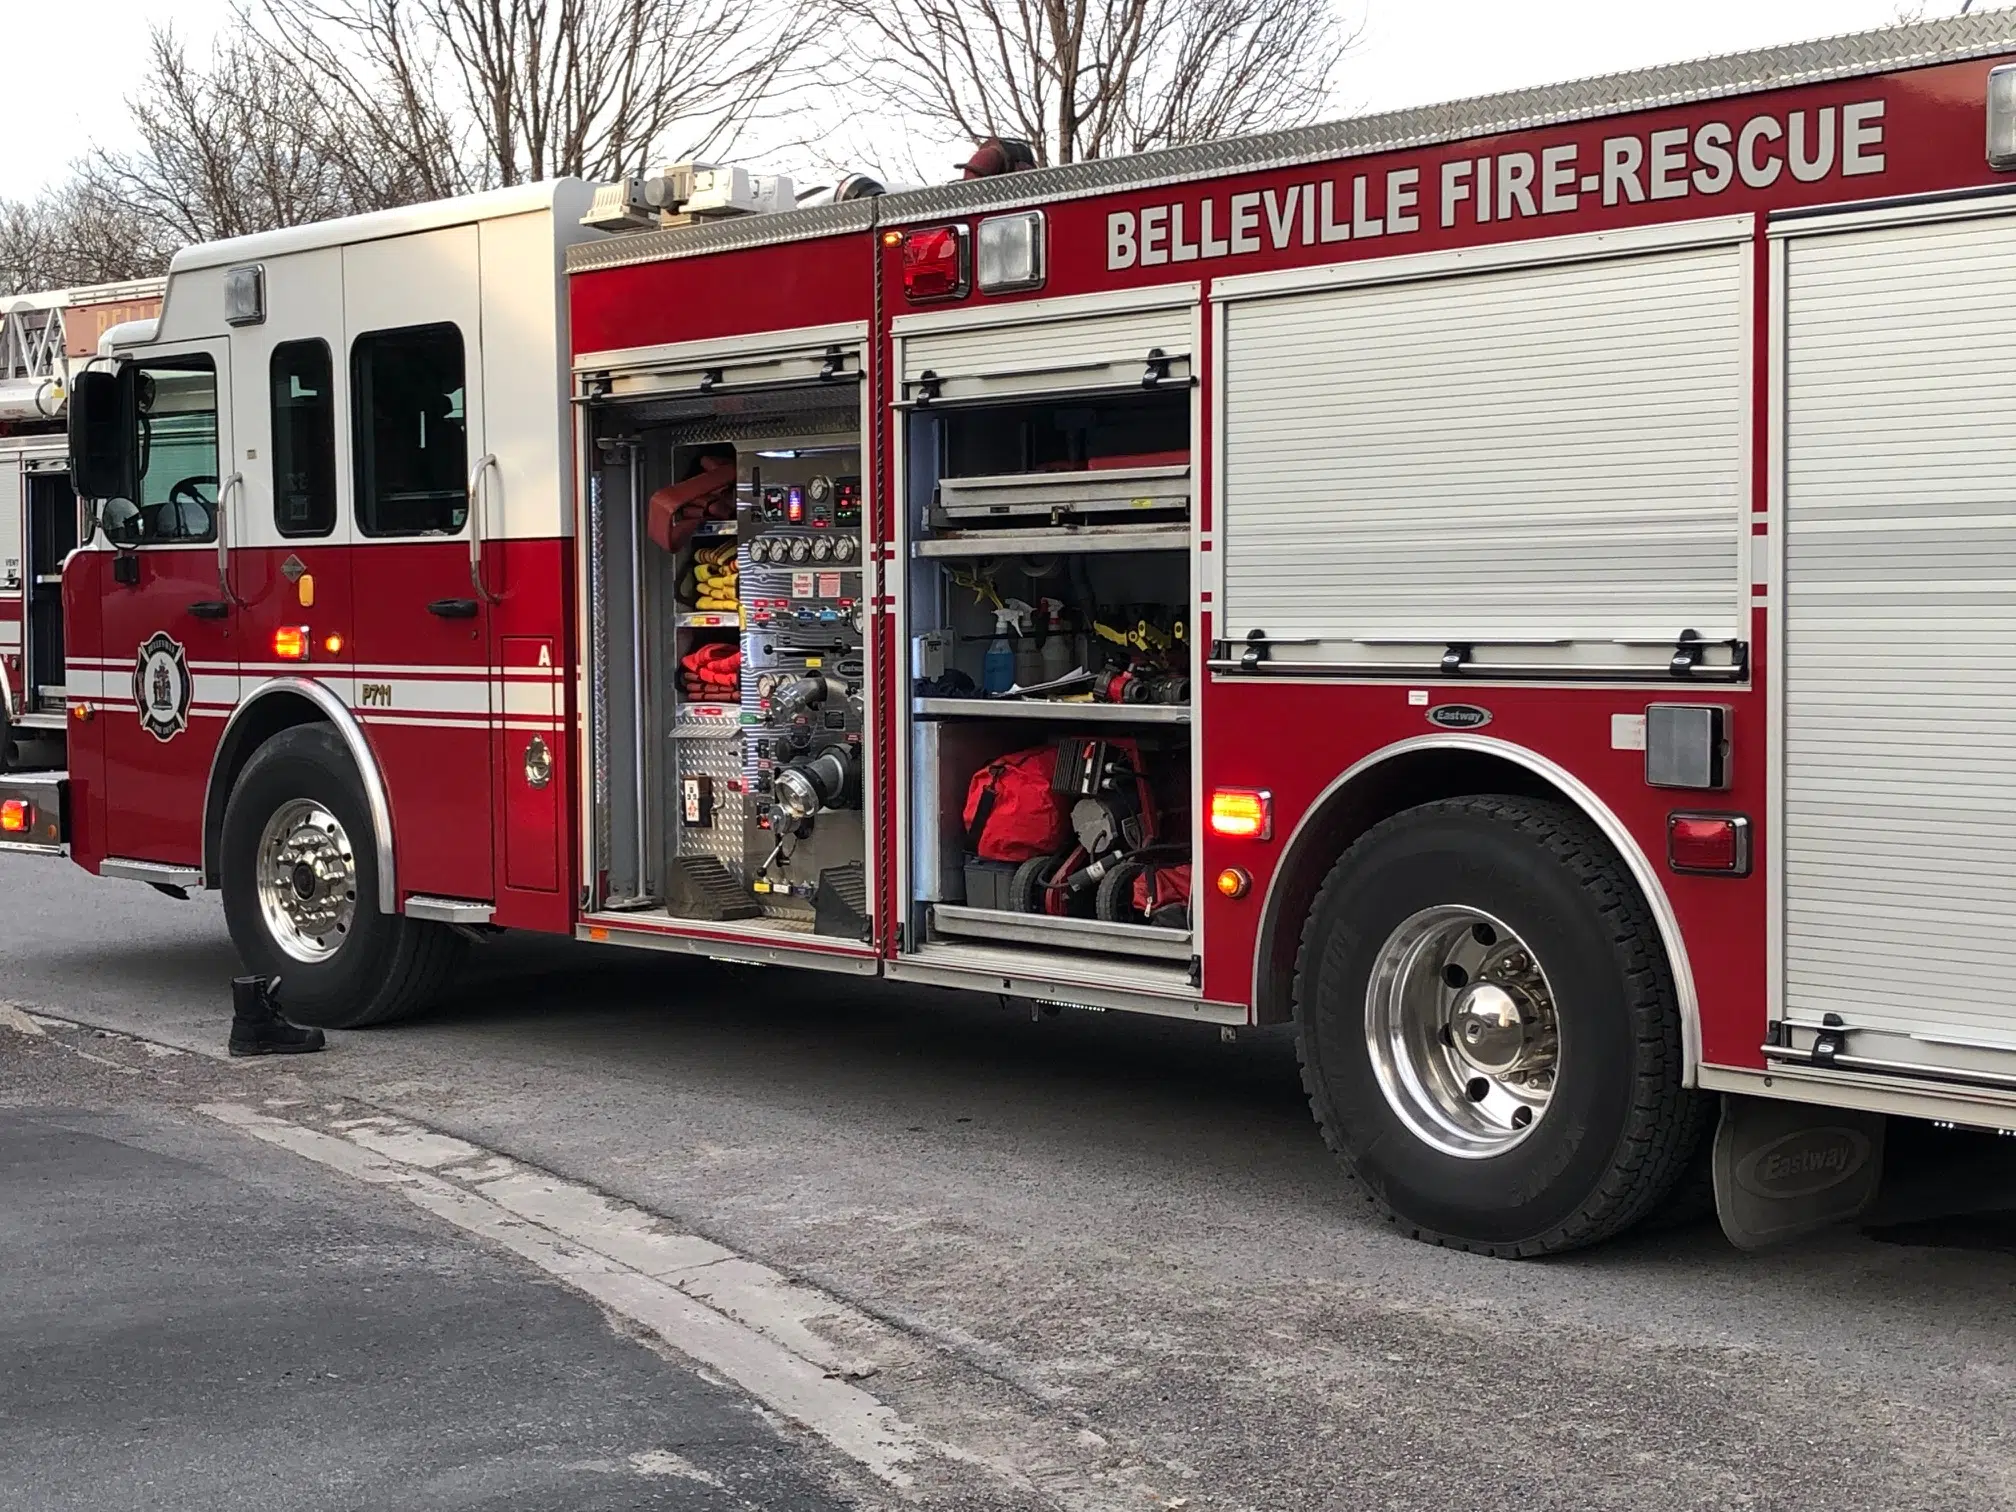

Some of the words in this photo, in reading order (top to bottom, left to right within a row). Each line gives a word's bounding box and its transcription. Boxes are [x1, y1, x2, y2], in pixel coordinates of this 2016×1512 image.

[1106, 167, 1420, 271] BELLEVILLE
[1440, 99, 1887, 229] FIRE-RESCUE
[538, 644, 551, 667] A
[362, 683, 392, 707] P711
[1436, 710, 1482, 723] Eastway
[1763, 1146, 1850, 1181] Eastway
